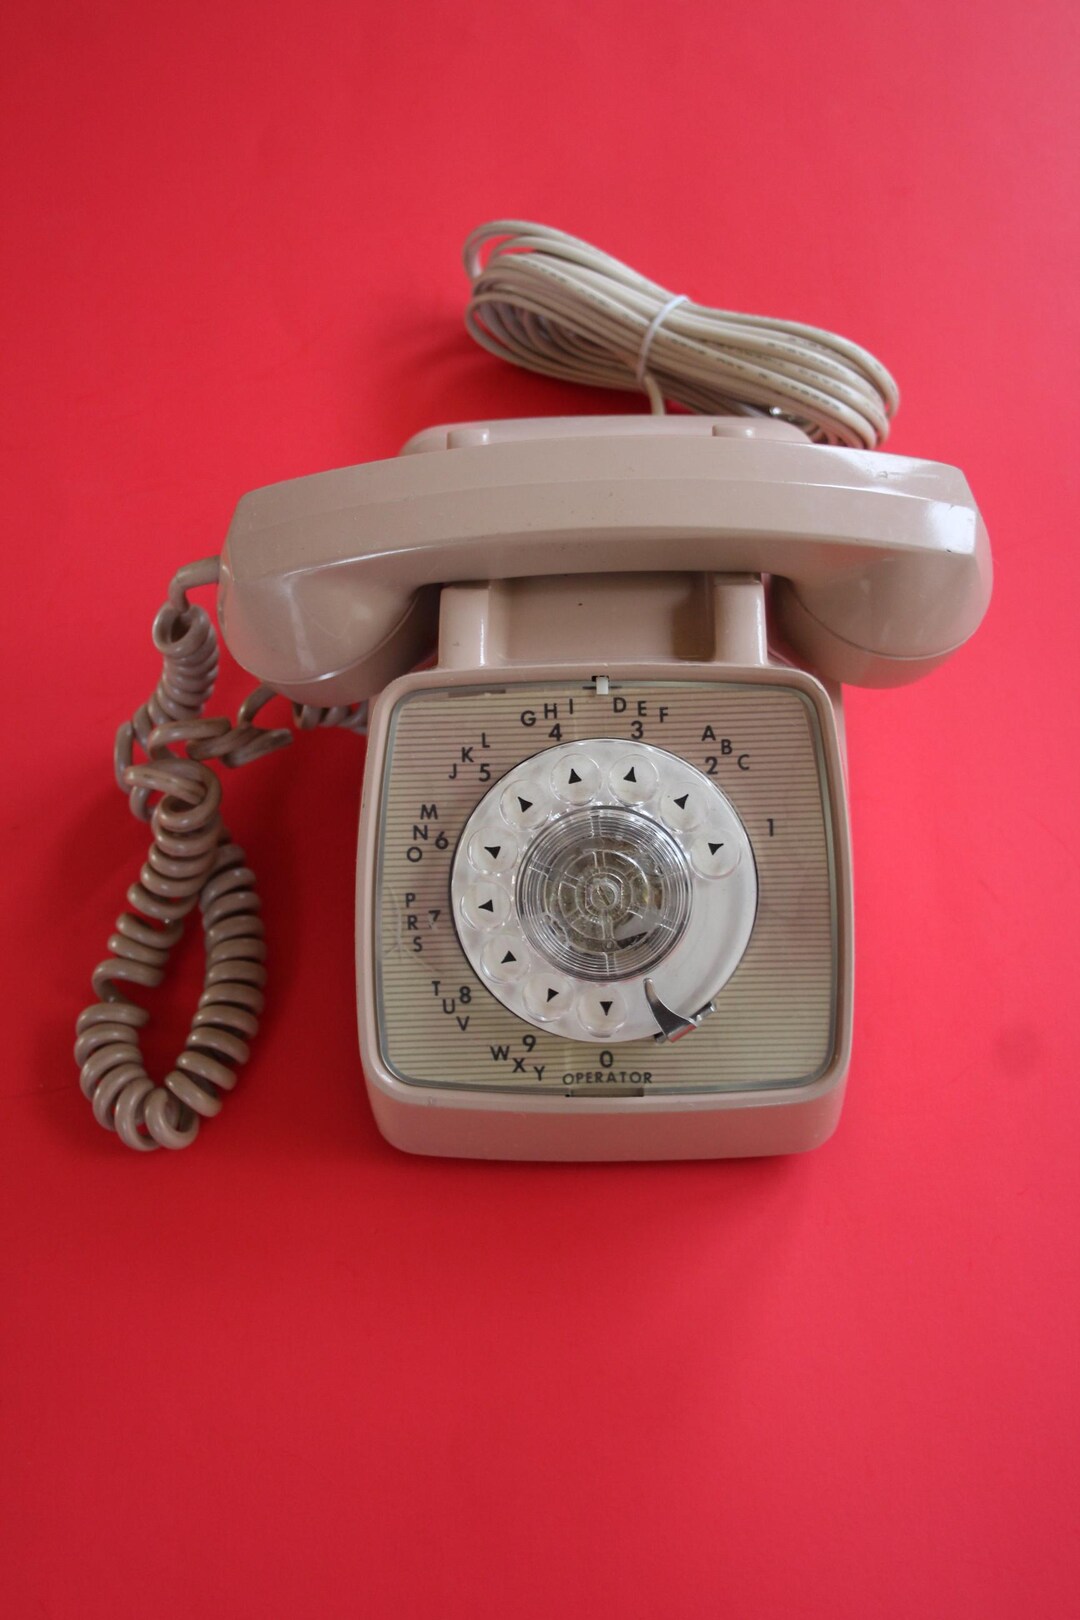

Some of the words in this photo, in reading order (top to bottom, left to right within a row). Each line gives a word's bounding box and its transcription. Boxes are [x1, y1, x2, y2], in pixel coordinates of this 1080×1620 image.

[548, 723, 563, 742] 4
[631, 721, 645, 739] 3
[478, 763, 491, 781] 5
[705, 756, 718, 775] 2
[766, 818, 774, 837] 1
[434, 831, 449, 850] 6
[428, 910, 441, 929] 7
[459, 986, 472, 1005] 8
[522, 1035, 536, 1053] 9
[599, 1050, 614, 1069] 0
[563, 1071, 653, 1085] OPERATOR
